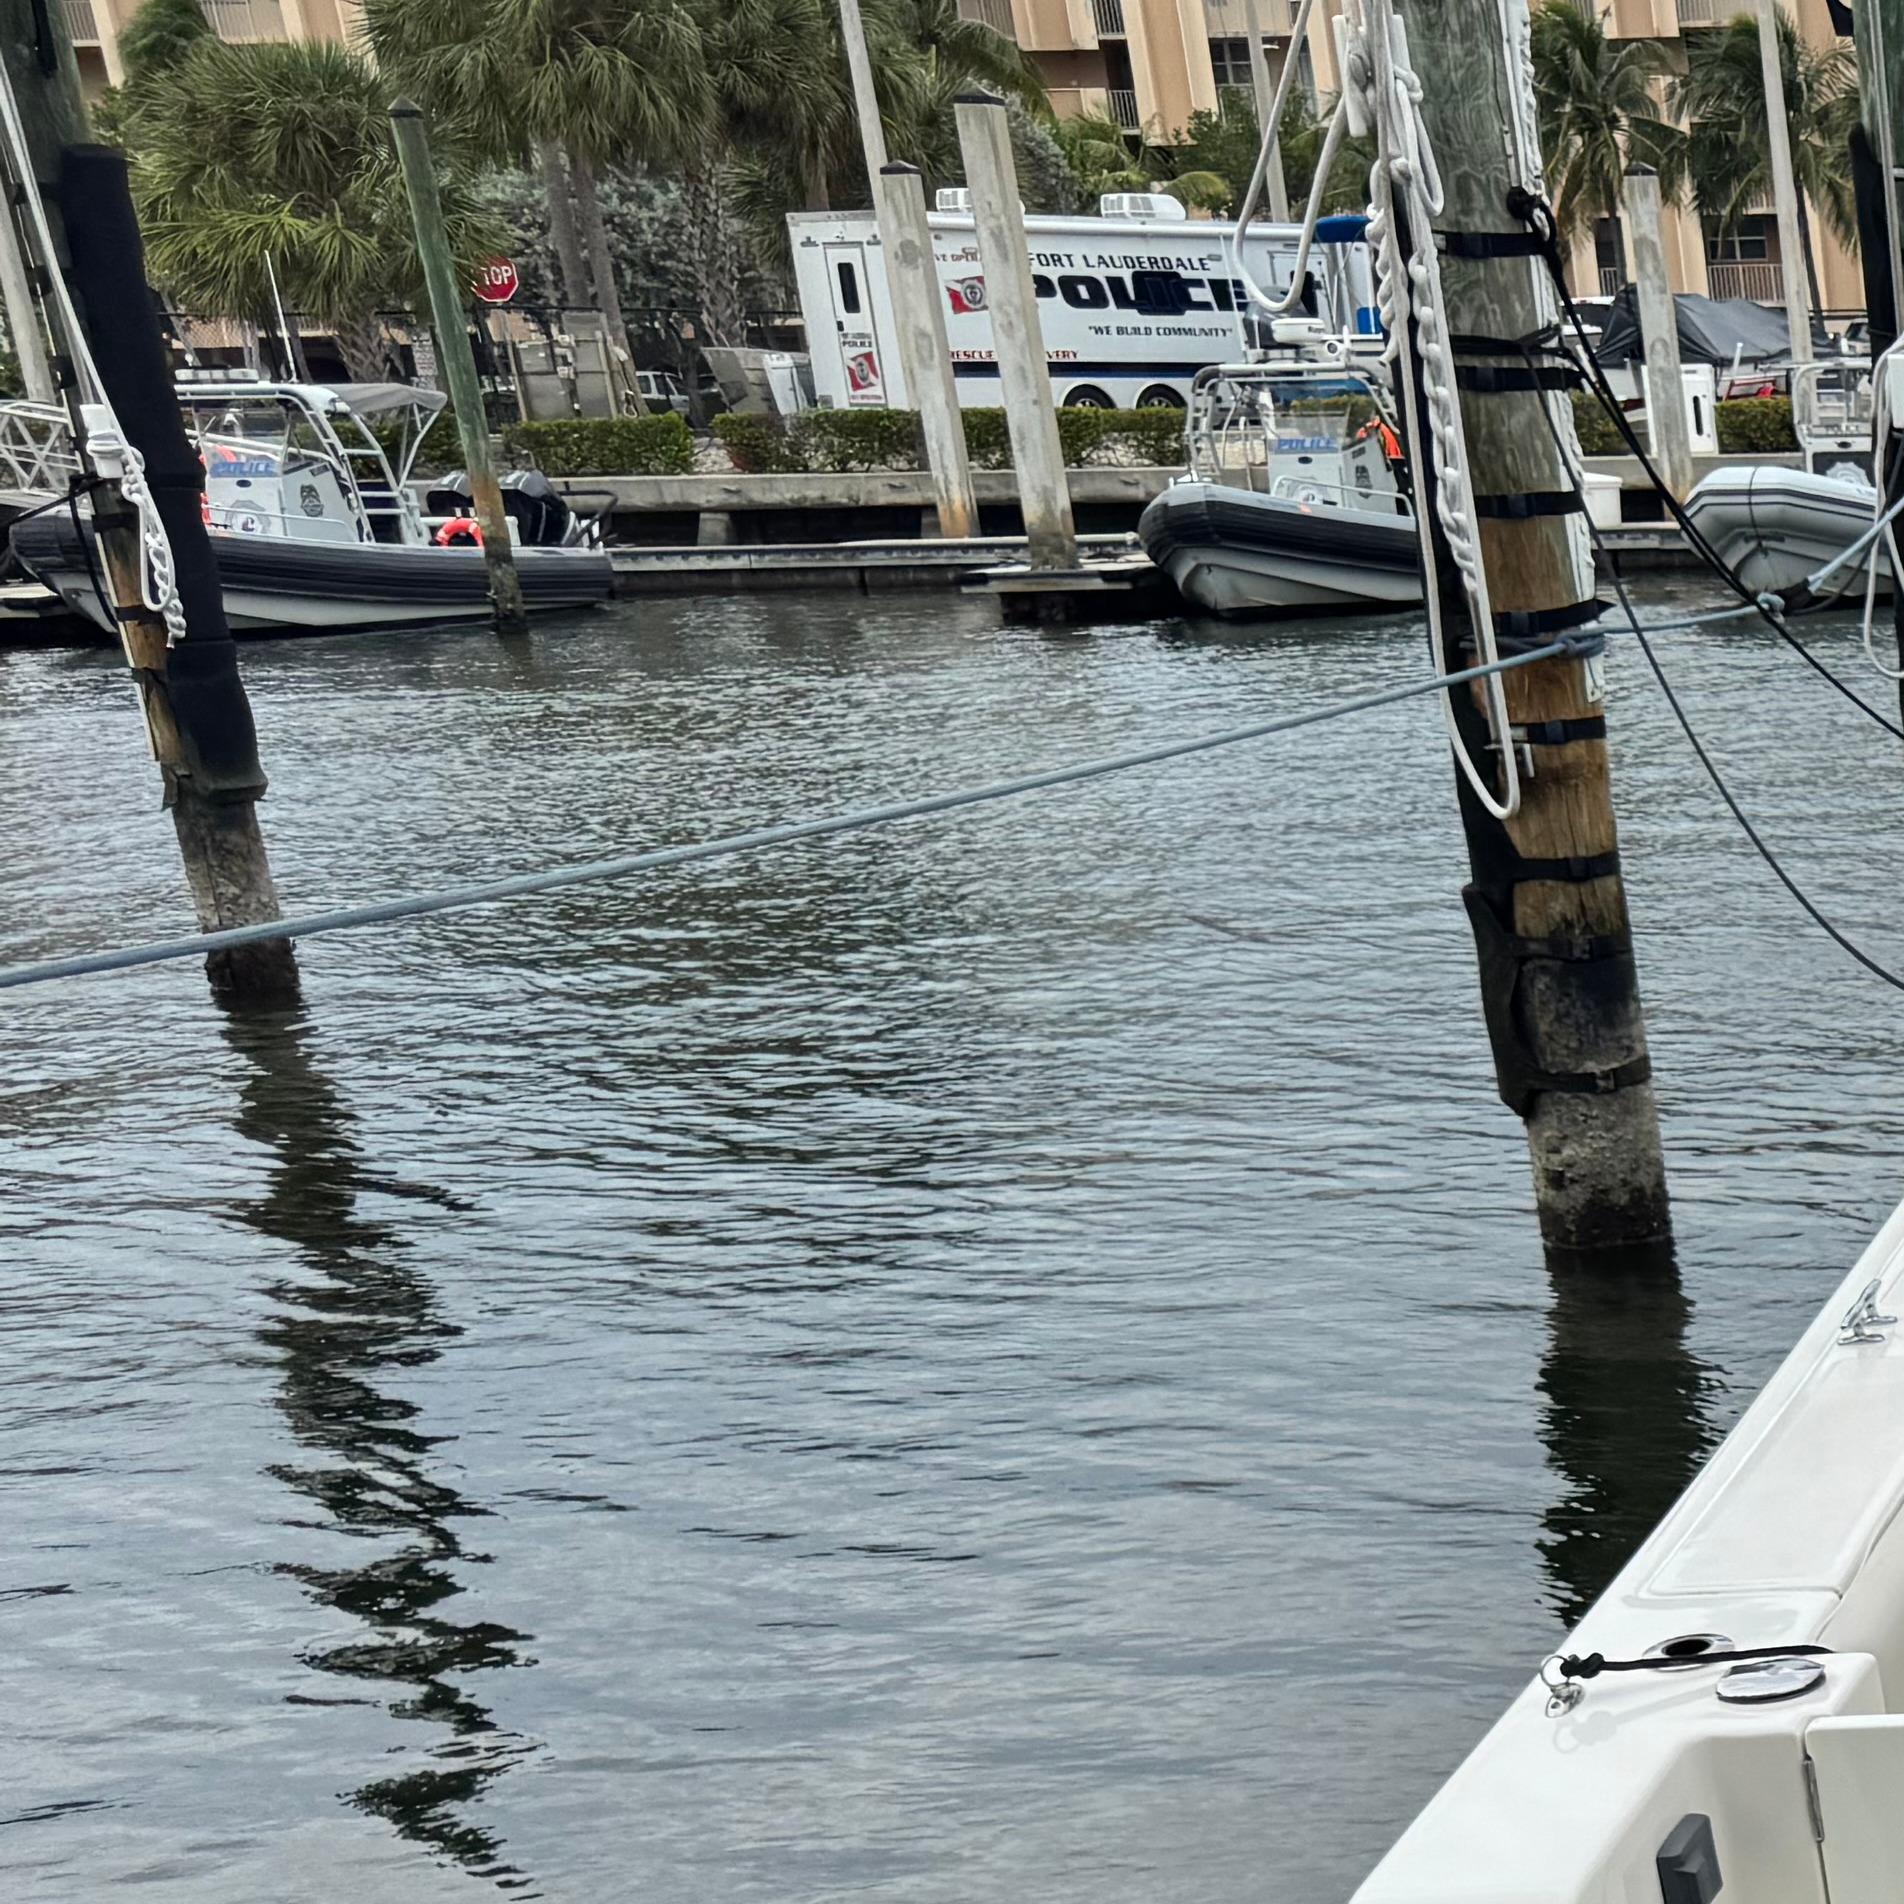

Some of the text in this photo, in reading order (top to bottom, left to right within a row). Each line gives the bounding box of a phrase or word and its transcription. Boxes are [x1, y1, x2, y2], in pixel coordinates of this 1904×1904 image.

[1029, 252, 1211, 271] FORT LAUDERDALE
[480, 265, 512, 286] TOP
[1115, 326, 1152, 337] BUILD
